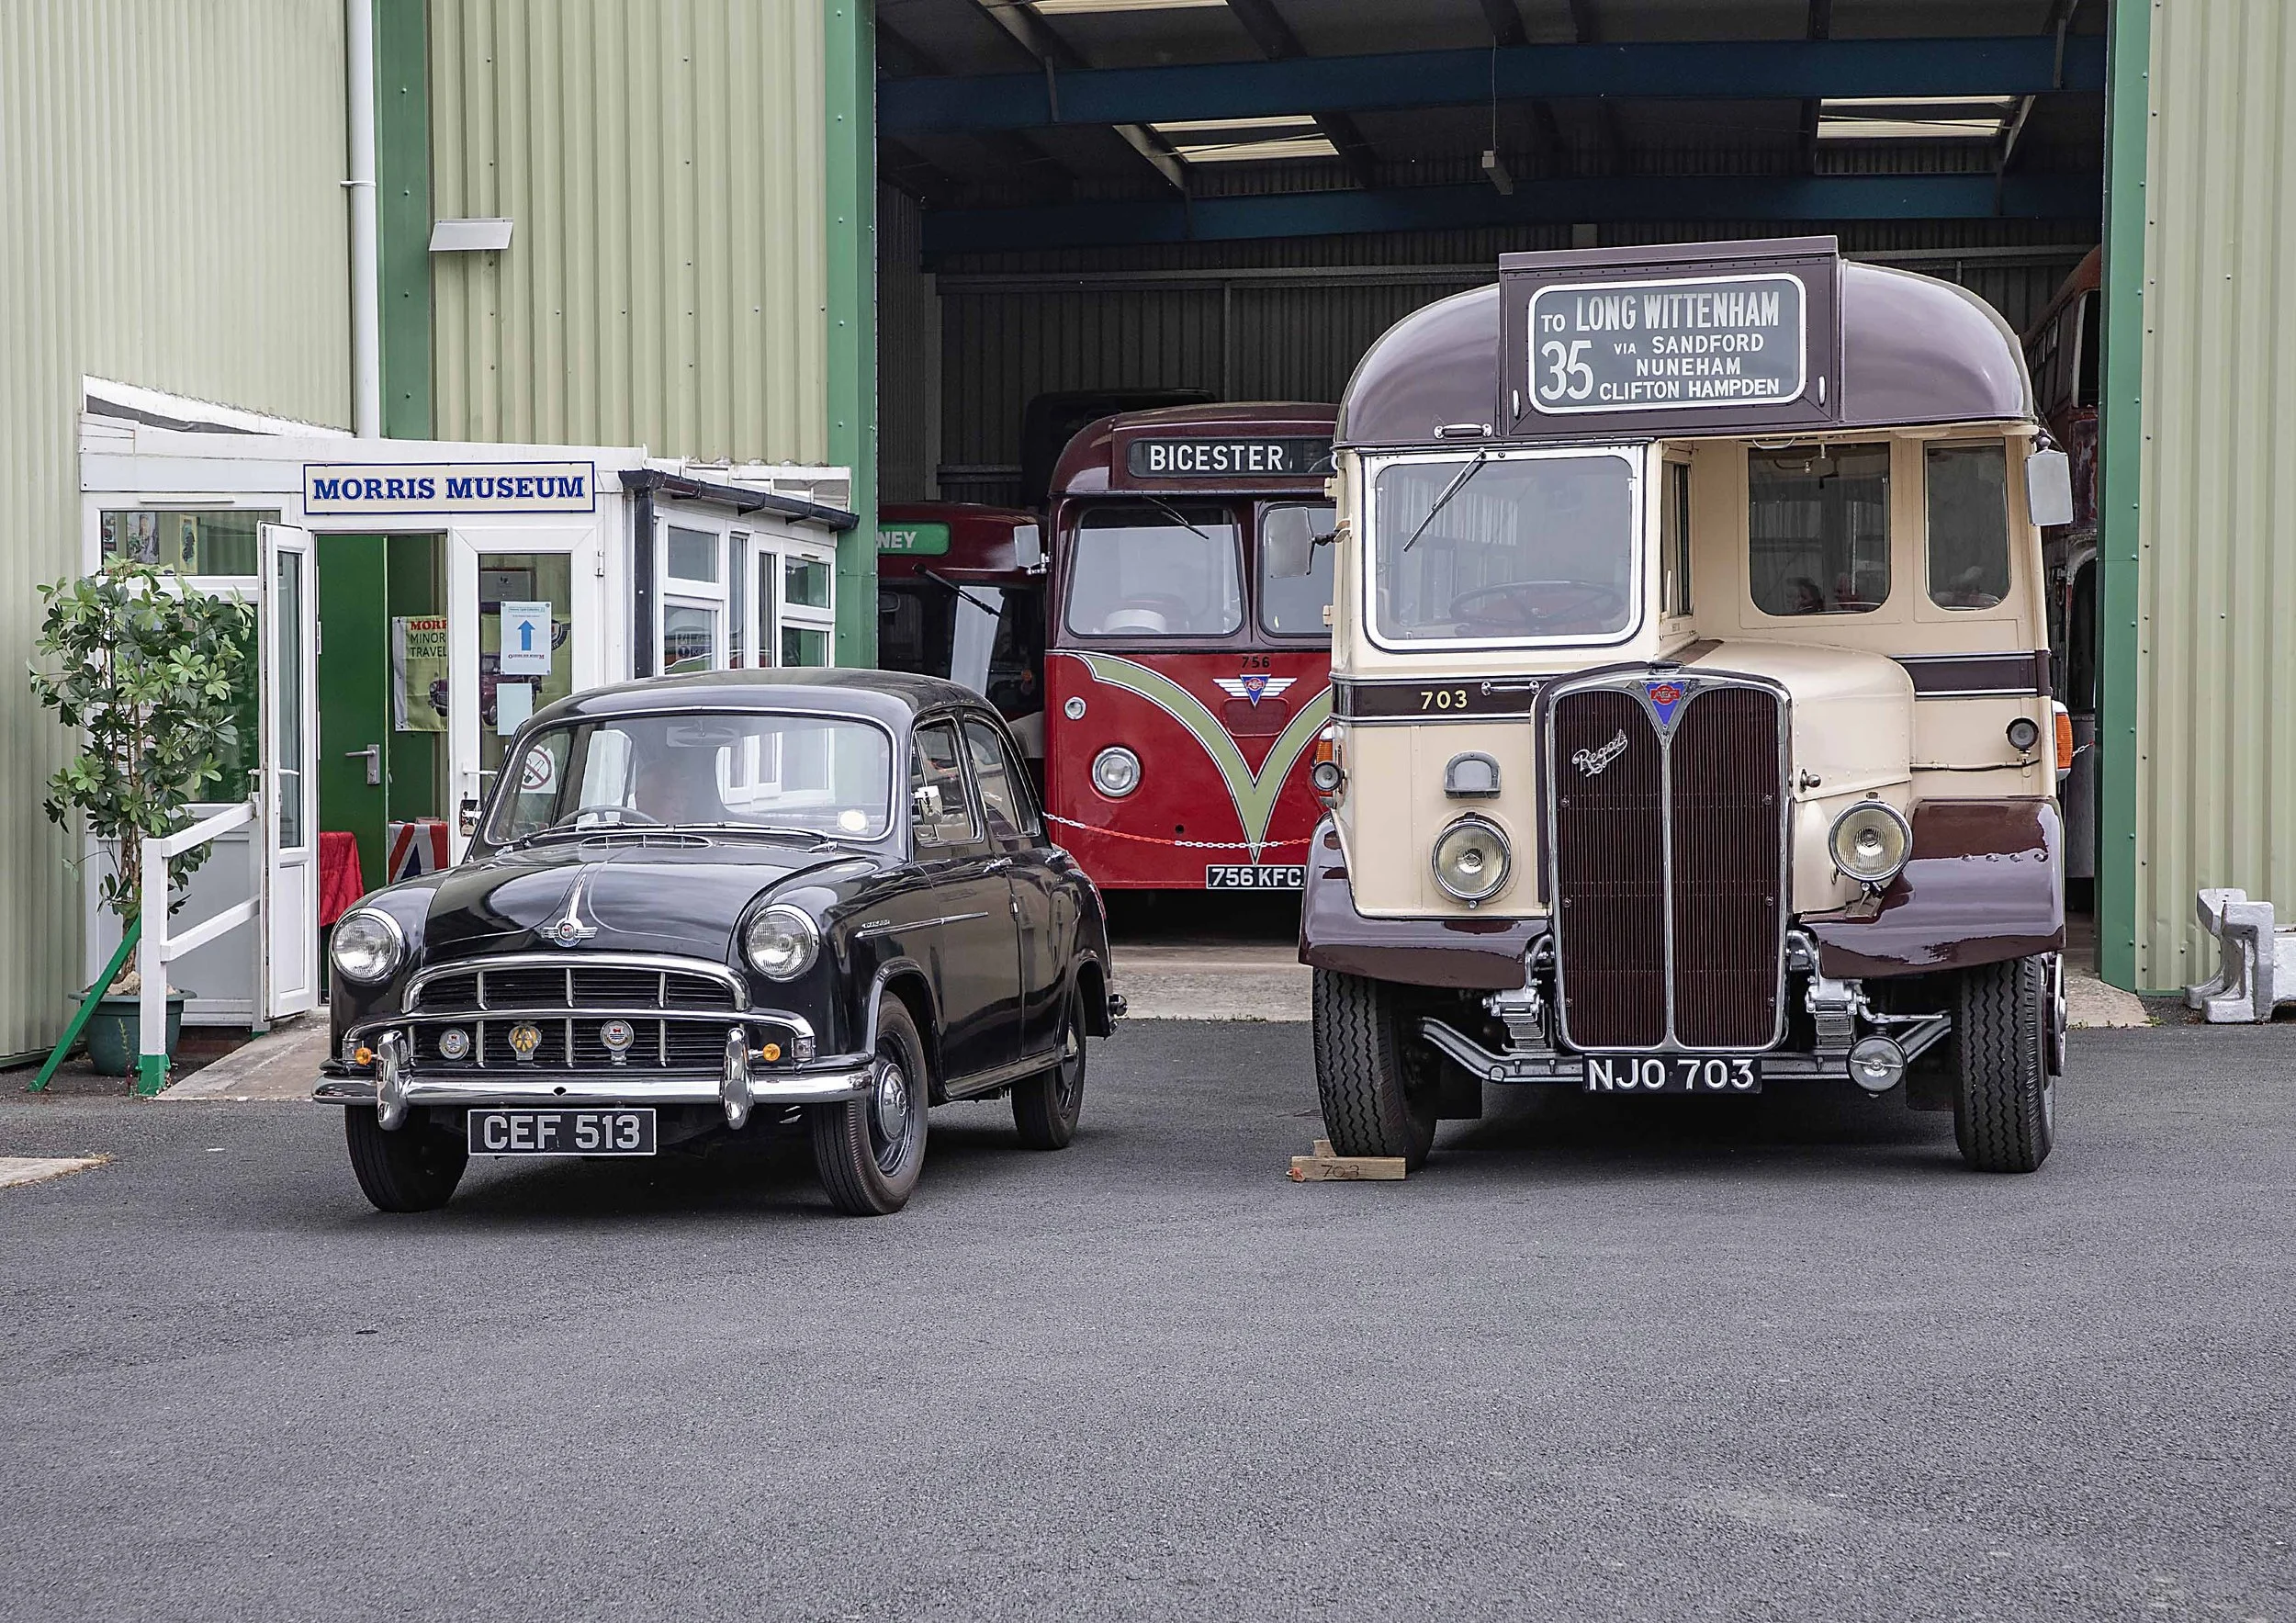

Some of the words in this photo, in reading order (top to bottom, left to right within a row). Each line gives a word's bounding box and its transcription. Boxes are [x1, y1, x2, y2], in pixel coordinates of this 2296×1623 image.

[1540, 313, 1567, 333] TO
[1576, 294, 1638, 332] LONG
[1643, 291, 1780, 330] WITTENHAM
[1614, 343, 1638, 355] VIA
[1652, 333, 1764, 355] SANDFORD
[1539, 340, 1594, 400] 35
[1636, 356, 1741, 377] NUNEHAM
[1599, 381, 1680, 400] CLIFTON
[1688, 378, 1780, 398] HAMPDEN
[1150, 445, 1284, 471] BICESTER
[312, 477, 436, 501] MORRIS
[445, 475, 586, 499] MUSEUM
[410, 632, 446, 644] MINOR
[1241, 656, 1270, 669] 756
[1420, 689, 1469, 710] 703
[1571, 728, 1628, 778] Regal
[1211, 867, 1255, 887] 756
[1258, 867, 1301, 887] KFC
[1588, 1058, 1666, 1091] NJO
[1677, 1058, 1755, 1091] 703
[483, 1114, 561, 1150] CEF
[575, 1114, 640, 1150] 513
[1321, 1164, 1360, 1178] 703
